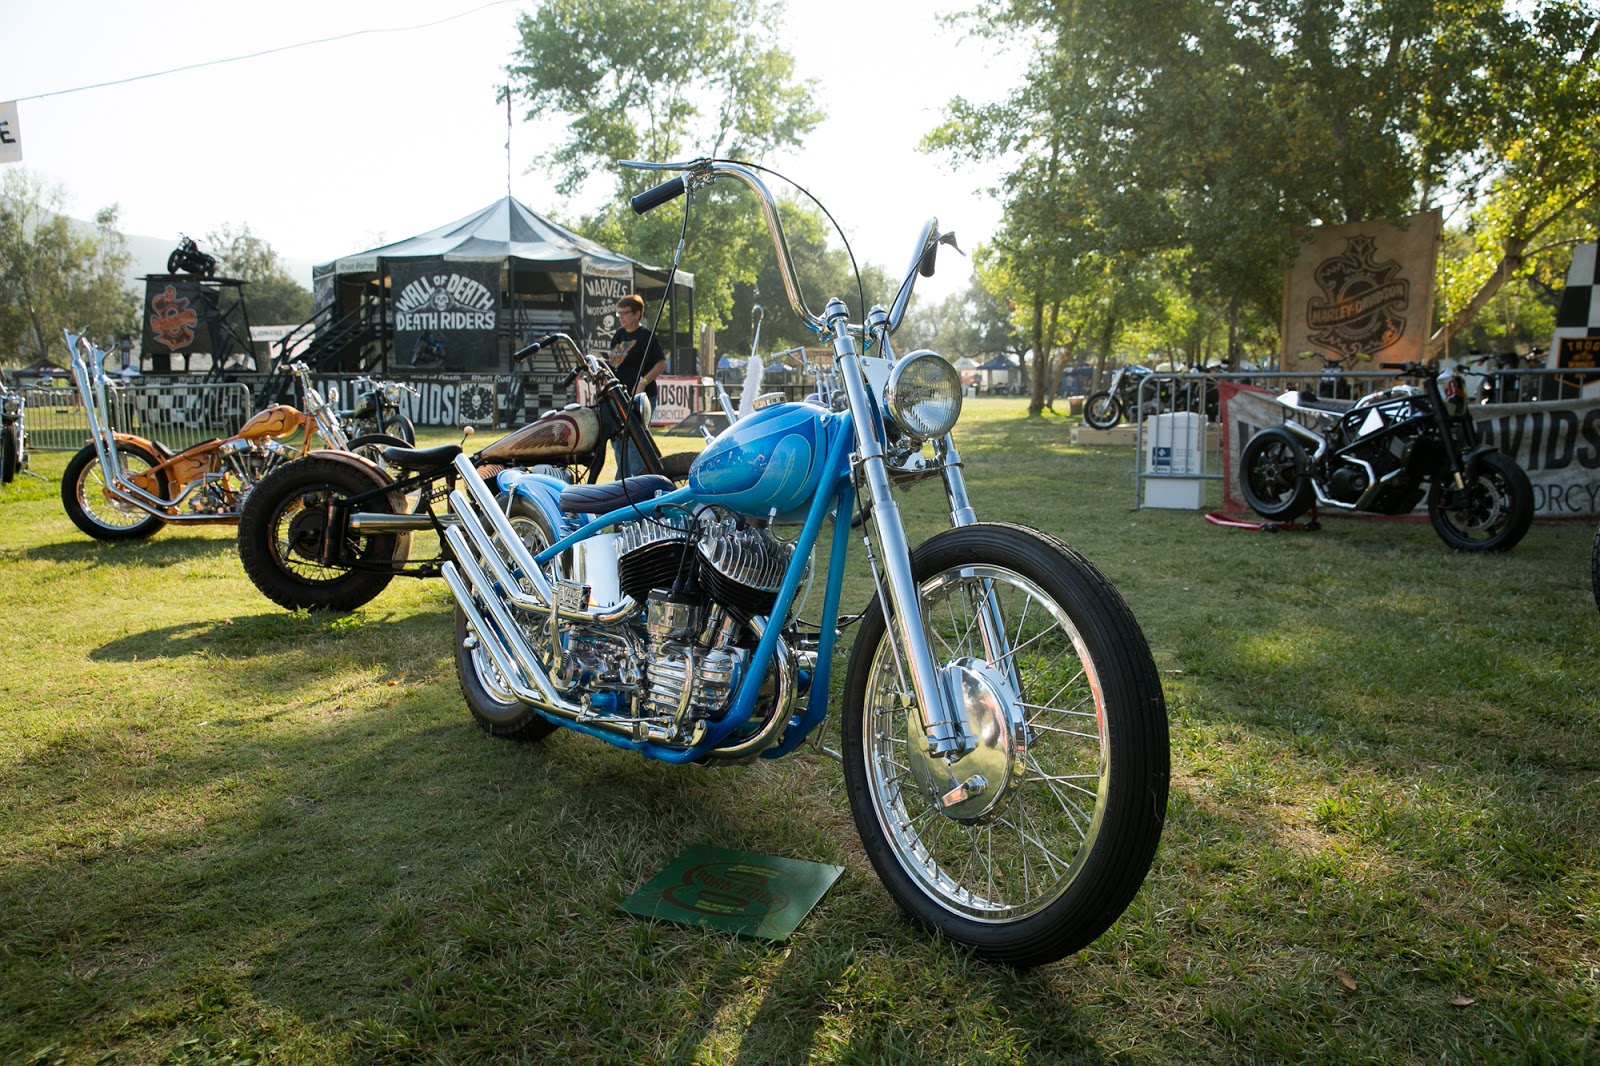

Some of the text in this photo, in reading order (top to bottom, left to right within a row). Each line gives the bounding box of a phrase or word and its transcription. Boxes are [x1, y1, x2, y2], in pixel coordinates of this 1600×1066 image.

[396, 273, 495, 312] WALL OF DEATH
[585, 278, 628, 298] MARVELS
[585, 304, 617, 316] MOTORDR
[396, 311, 496, 331] DEATH RIDERS
[651, 409, 685, 420] OTORCYCLE
